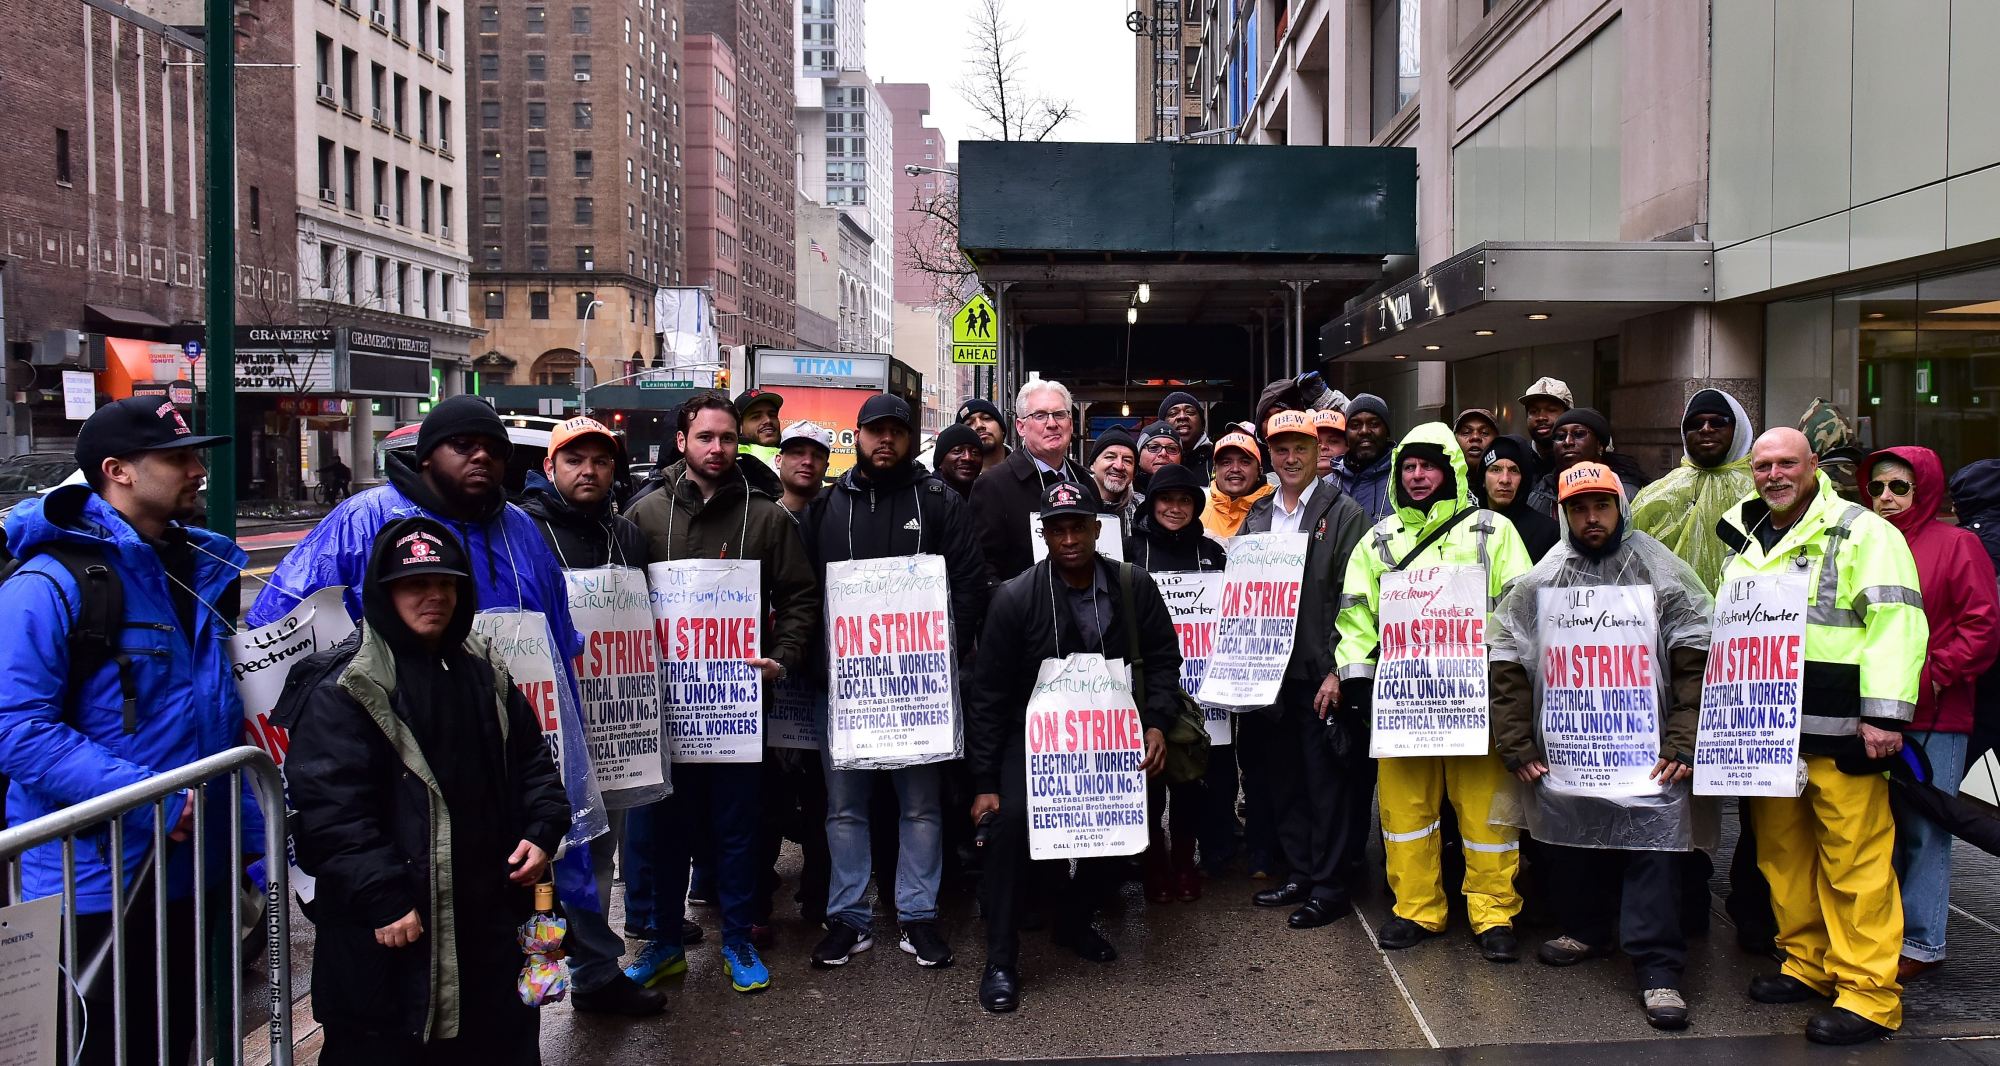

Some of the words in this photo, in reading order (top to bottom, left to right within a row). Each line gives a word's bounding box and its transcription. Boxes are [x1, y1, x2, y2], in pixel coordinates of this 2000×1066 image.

[249, 329, 331, 340] GRAMERCY
[351, 331, 396, 350] GRAMERCY
[397, 338, 429, 353] THEATRE
[277, 354, 299, 364] FOR
[958, 348, 997, 360] AHEAD
[244, 366, 274, 375] SOUP
[793, 358, 852, 375] TITAN
[235, 377, 263, 387] SOLD
[268, 377, 293, 387] OUT
[565, 418, 602, 431] IBEW
[1275, 413, 1305, 426] IBEW
[1312, 412, 1339, 423] IBEW
[1566, 468, 1601, 485] IBEW
[1571, 480, 1591, 488] LOCAL
[414, 544, 427, 556] 3
[1408, 567, 1439, 584] ULP
[1222, 581, 1242, 617] ON
[1243, 581, 1299, 617] STRIKE
[1569, 589, 1595, 609] ULP
[1730, 580, 1755, 604] ULP
[253, 616, 298, 648] ULP
[835, 616, 863, 657] ON
[869, 611, 945, 655] STRIKE
[1219, 618, 1257, 636] ELECTRICAL
[1260, 618, 1294, 637] WORKERS
[676, 617, 756, 660] STRIKE
[1216, 637, 1242, 654] LOCAL
[1245, 637, 1272, 655] UNION
[1272, 638, 1292, 655] No.3
[1383, 622, 1407, 661] ON
[1411, 619, 1483, 658] STRIKE
[590, 630, 655, 677] STRIKE
[1706, 641, 1724, 685] ON
[1727, 635, 1800, 682] STRIKE
[706, 661, 756, 681] WORKERS
[837, 656, 894, 678] ELECTRICAL
[899, 652, 946, 674] WORKERS
[1209, 667, 1250, 680] ELECTRICAL
[1252, 669, 1283, 681] WORKERS
[1379, 659, 1431, 680] ELECTRICAL
[1437, 659, 1484, 678] WORKERS
[1544, 646, 1567, 688] ON
[1572, 645, 1652, 688] STRIKE
[618, 675, 656, 699] WORKERS
[685, 683, 726, 704] UNION
[730, 682, 758, 703] No.3
[838, 678, 876, 699] LOCAL
[880, 675, 918, 697] UNION
[922, 674, 948, 694] No.3
[1377, 680, 1414, 700] LOCAL
[1417, 679, 1455, 699] UNION
[1459, 679, 1485, 698] No.3
[1703, 684, 1743, 708] ELECTRICAL
[1749, 682, 1797, 706] WORKERS
[838, 706, 888, 715] International
[891, 702, 941, 711] Brotherhood
[858, 697, 910, 705] ESTABLISHED
[1546, 689, 1596, 711] ELECTRICAL
[1601, 689, 1652, 711] WORKERS
[600, 700, 634, 724] UNION
[637, 698, 659, 721] No.3
[695, 711, 749, 719] Brotherhood
[749, 710, 757, 718] of
[1377, 707, 1426, 715] International
[1428, 706, 1476, 714] Brotherhood
[1701, 708, 1727, 731] LOCAL
[1730, 707, 1765, 729] UNION
[1769, 707, 1796, 728] No.3
[629, 722, 642, 730] 1891
[705, 719, 757, 735] WORKERS
[838, 713, 898, 730] ELECTRICAL
[900, 710, 949, 727] WORKERS
[1377, 715, 1435, 730] ELECTRICAL
[1437, 714, 1486, 729] WORKERS
[1546, 712, 1578, 732] LOCAL
[1581, 712, 1622, 734] UNION
[609, 730, 651, 740] Brotherhood
[652, 728, 658, 736] of
[1029, 711, 1059, 753] ON
[1065, 709, 1141, 752] STRIKE
[618, 737, 658, 757] WORKERS
[1547, 741, 1590, 749] International
[1592, 742, 1645, 750] Brotherhood
[1699, 739, 1736, 747] International
[1738, 738, 1784, 746] Brotherhood
[1786, 738, 1794, 746] of
[1031, 753, 1089, 775] ELECTRICAL
[1095, 751, 1142, 772] WORKERS
[1549, 749, 1600, 767] ELECTRICAL
[1602, 751, 1656, 767] WORKERS
[1697, 748, 1744, 764] ELECTRICAL
[1747, 748, 1793, 764] WORKERS
[597, 766, 624, 774] AFL-CIO
[1032, 776, 1071, 797] LOCAL
[1075, 774, 1113, 795] UNION
[1117, 773, 1143, 793] No.3
[1033, 804, 1083, 813] International
[1086, 801, 1134, 810] Brotherhood
[1033, 812, 1093, 829] ELECTRICAL
[1096, 810, 1144, 826] WORKERS
[1, 931, 34, 947] PICKETERS
